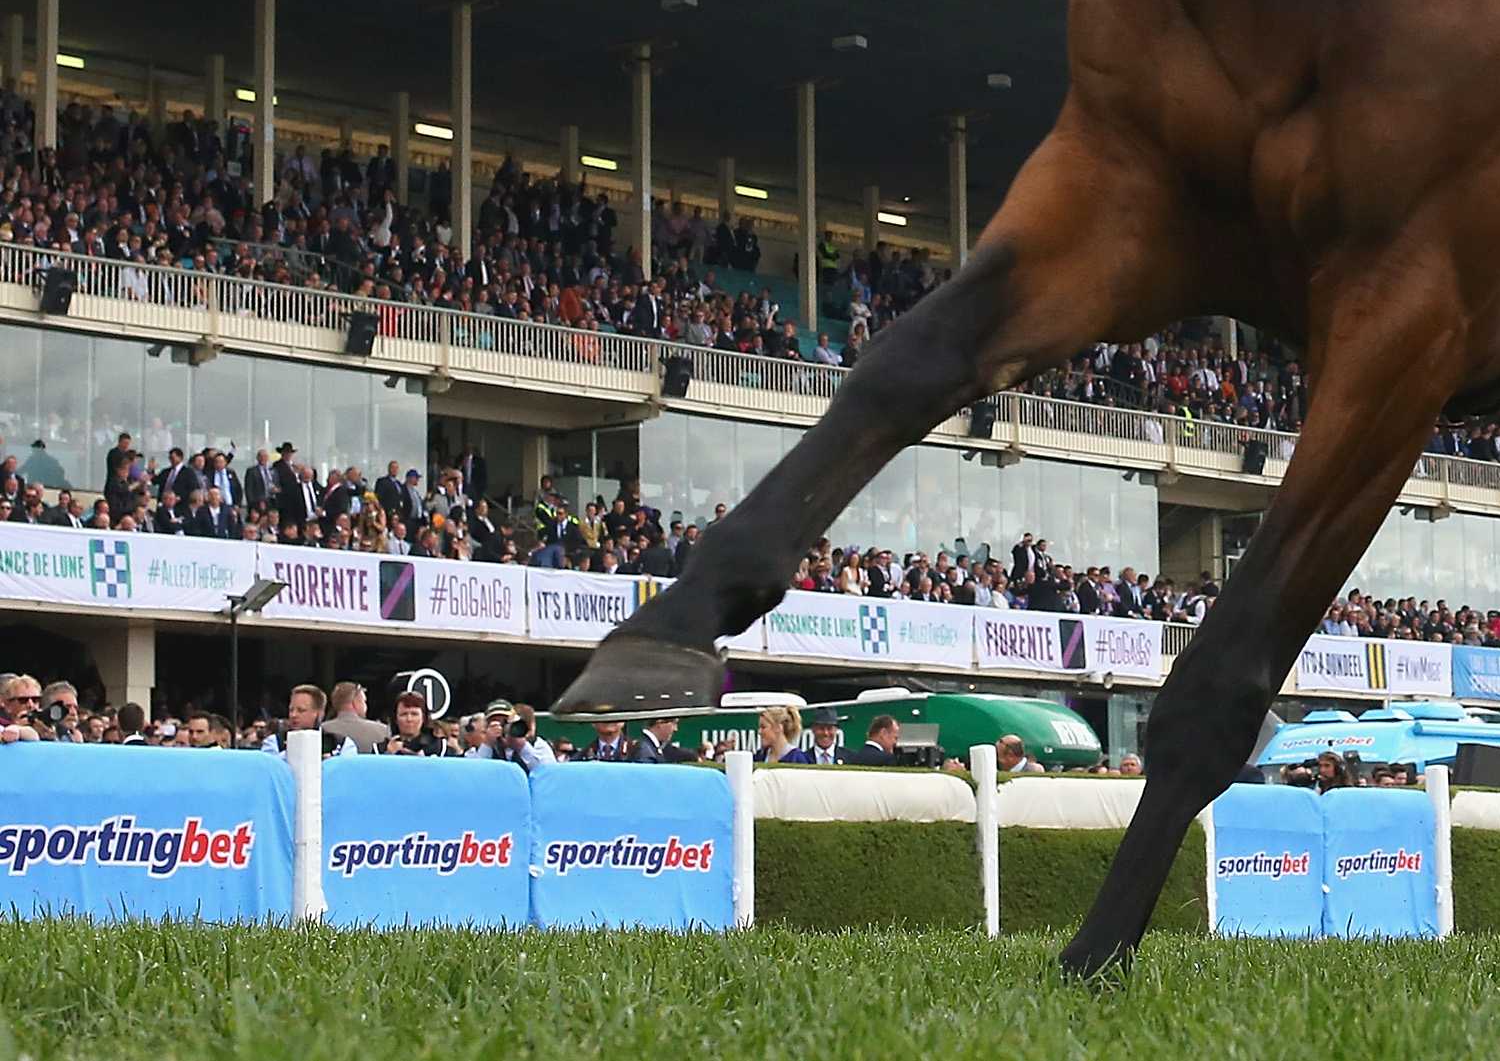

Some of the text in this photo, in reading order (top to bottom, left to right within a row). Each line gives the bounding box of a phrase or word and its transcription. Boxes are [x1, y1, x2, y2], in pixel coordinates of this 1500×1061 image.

[33, 551, 49, 578] DE
[52, 554, 85, 580] LUNE
[274, 561, 369, 612] FIORENTE
[536, 590, 561, 620] IT'S
[564, 592, 573, 621] A
[820, 614, 833, 638] DE
[834, 616, 857, 639] LUNE
[985, 621, 1055, 662] FIORENTE
[422, 678, 433, 711] 1
[0, 818, 251, 876] sportingbet
[331, 832, 513, 874] sportingbet
[546, 837, 713, 875] sportingbet
[1336, 849, 1421, 878] sportingbet
[1218, 853, 1310, 878] sportingbet
